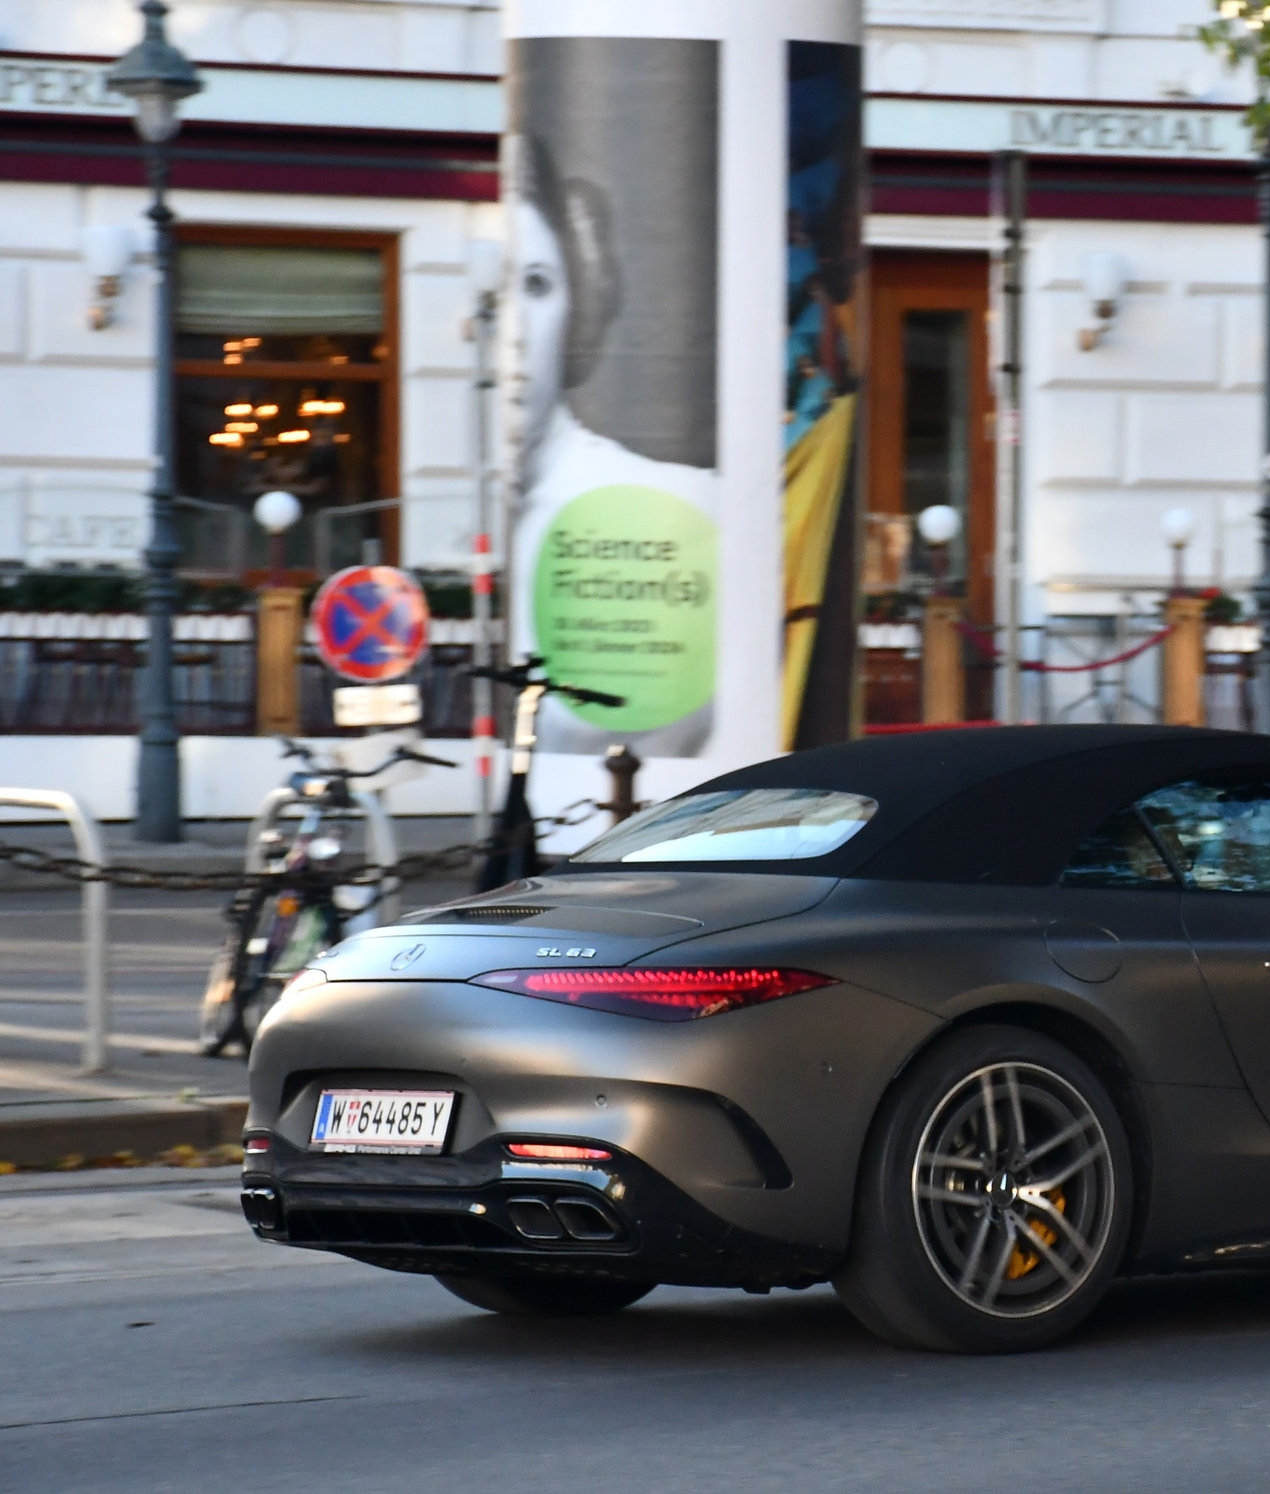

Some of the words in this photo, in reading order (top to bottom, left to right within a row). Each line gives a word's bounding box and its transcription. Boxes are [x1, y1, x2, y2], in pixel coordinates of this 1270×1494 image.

[1010, 110, 1227, 152] IMPERIAL
[553, 530, 678, 561] Science
[553, 570, 710, 608] Fiction(s)
[536, 947, 562, 957] SL
[566, 947, 596, 958] 63
[330, 1100, 347, 1134] W
[358, 1101, 426, 1135] 64485
[431, 1102, 444, 1136] Y
